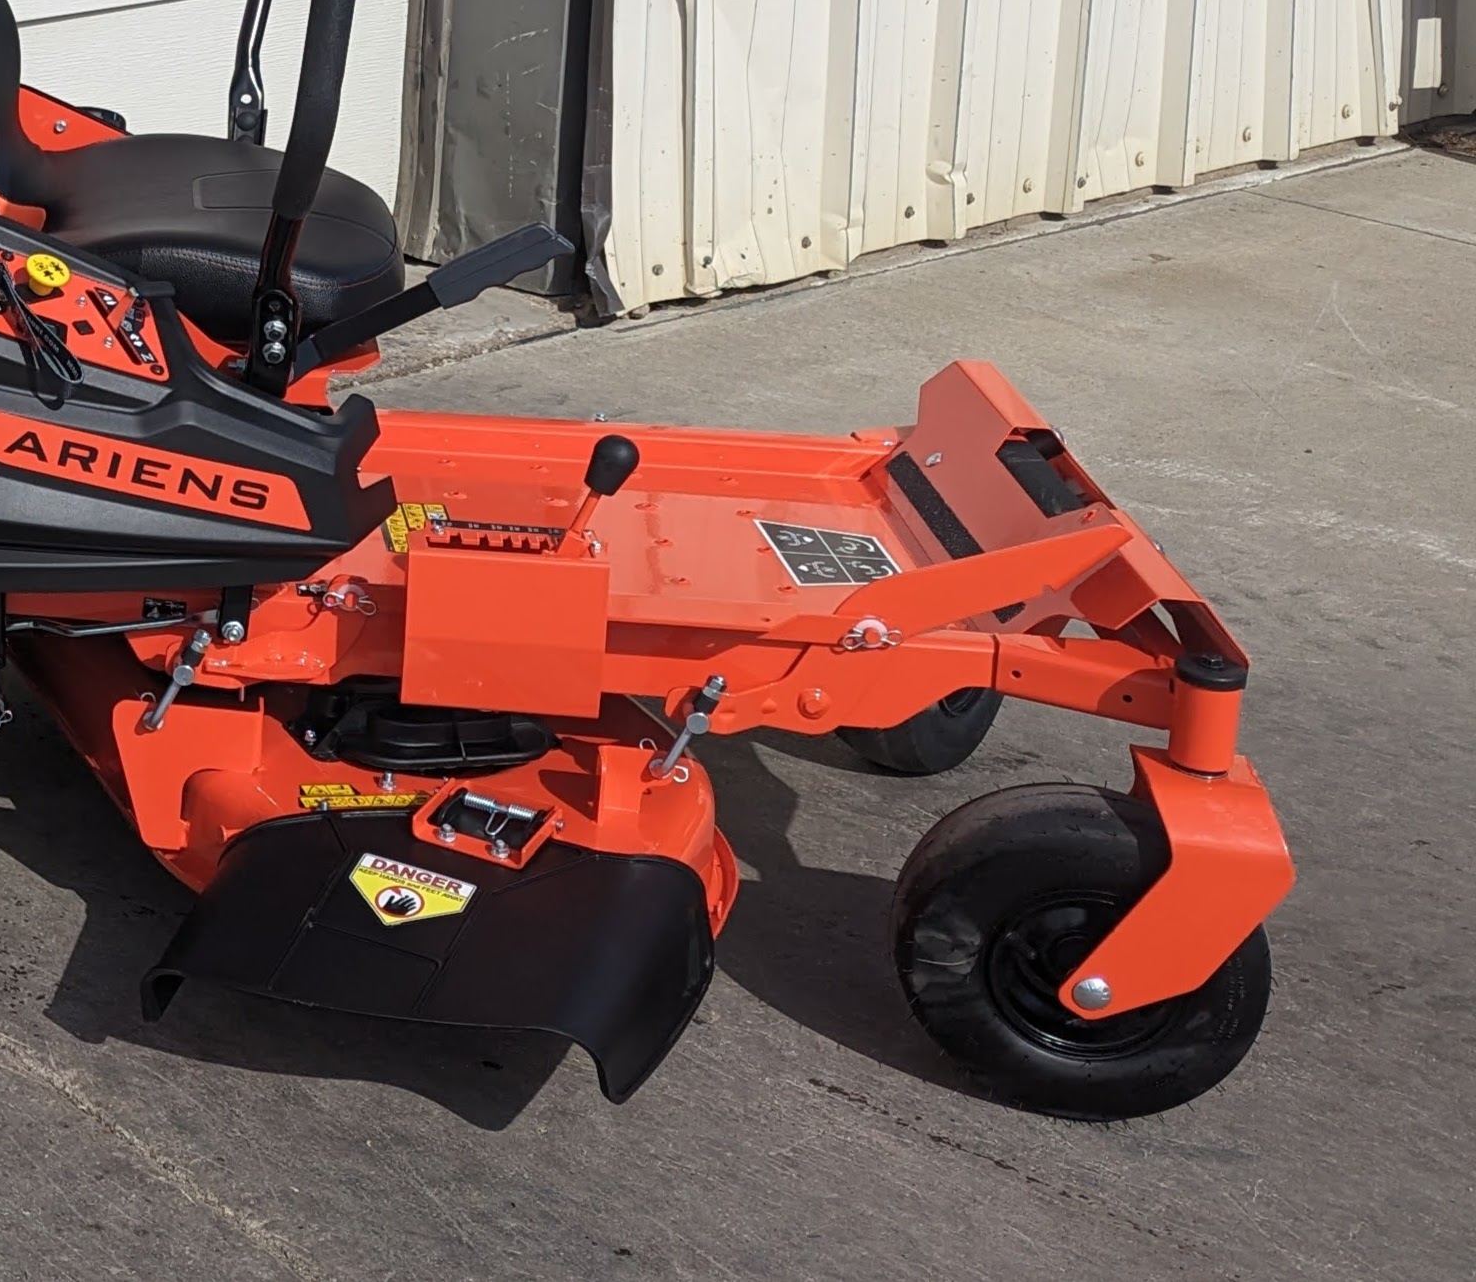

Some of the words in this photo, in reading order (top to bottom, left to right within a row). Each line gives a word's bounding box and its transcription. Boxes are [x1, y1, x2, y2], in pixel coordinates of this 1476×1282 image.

[4, 431, 271, 511] ARIENS
[358, 867, 379, 877] KEEP
[378, 873, 405, 885] HANDS
[421, 885, 442, 896] FEET
[440, 892, 464, 904] AWAY
[370, 858, 462, 896] DANGER
